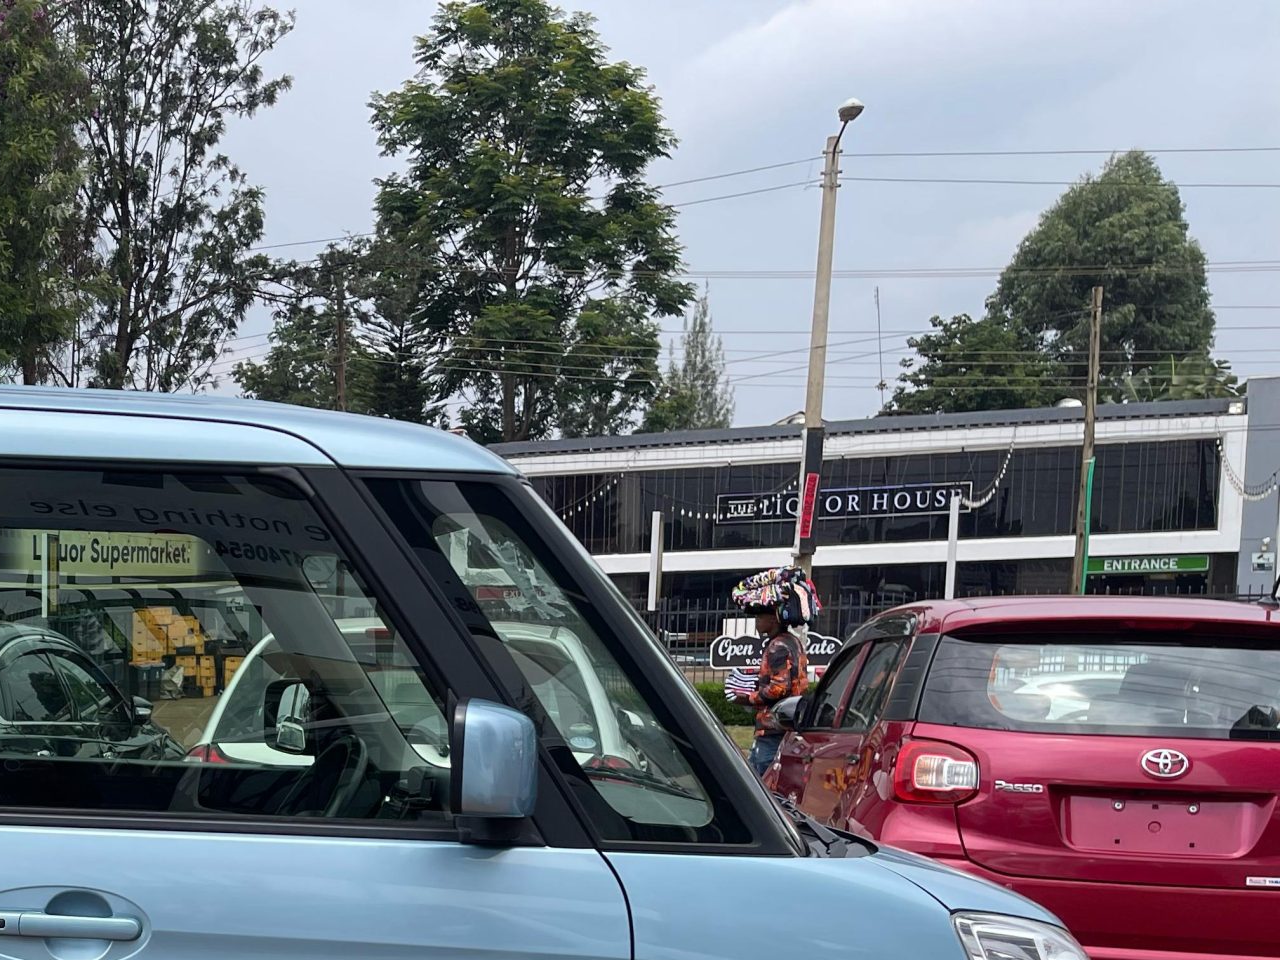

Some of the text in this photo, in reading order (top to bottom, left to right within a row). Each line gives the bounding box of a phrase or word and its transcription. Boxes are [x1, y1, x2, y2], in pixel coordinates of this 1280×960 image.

[728, 502, 755, 515] THE
[762, 495, 860, 517] LIQOR
[32, 534, 86, 563] Luor
[1103, 557, 1179, 571] ENTRANCE
[718, 638, 755, 661] Open
